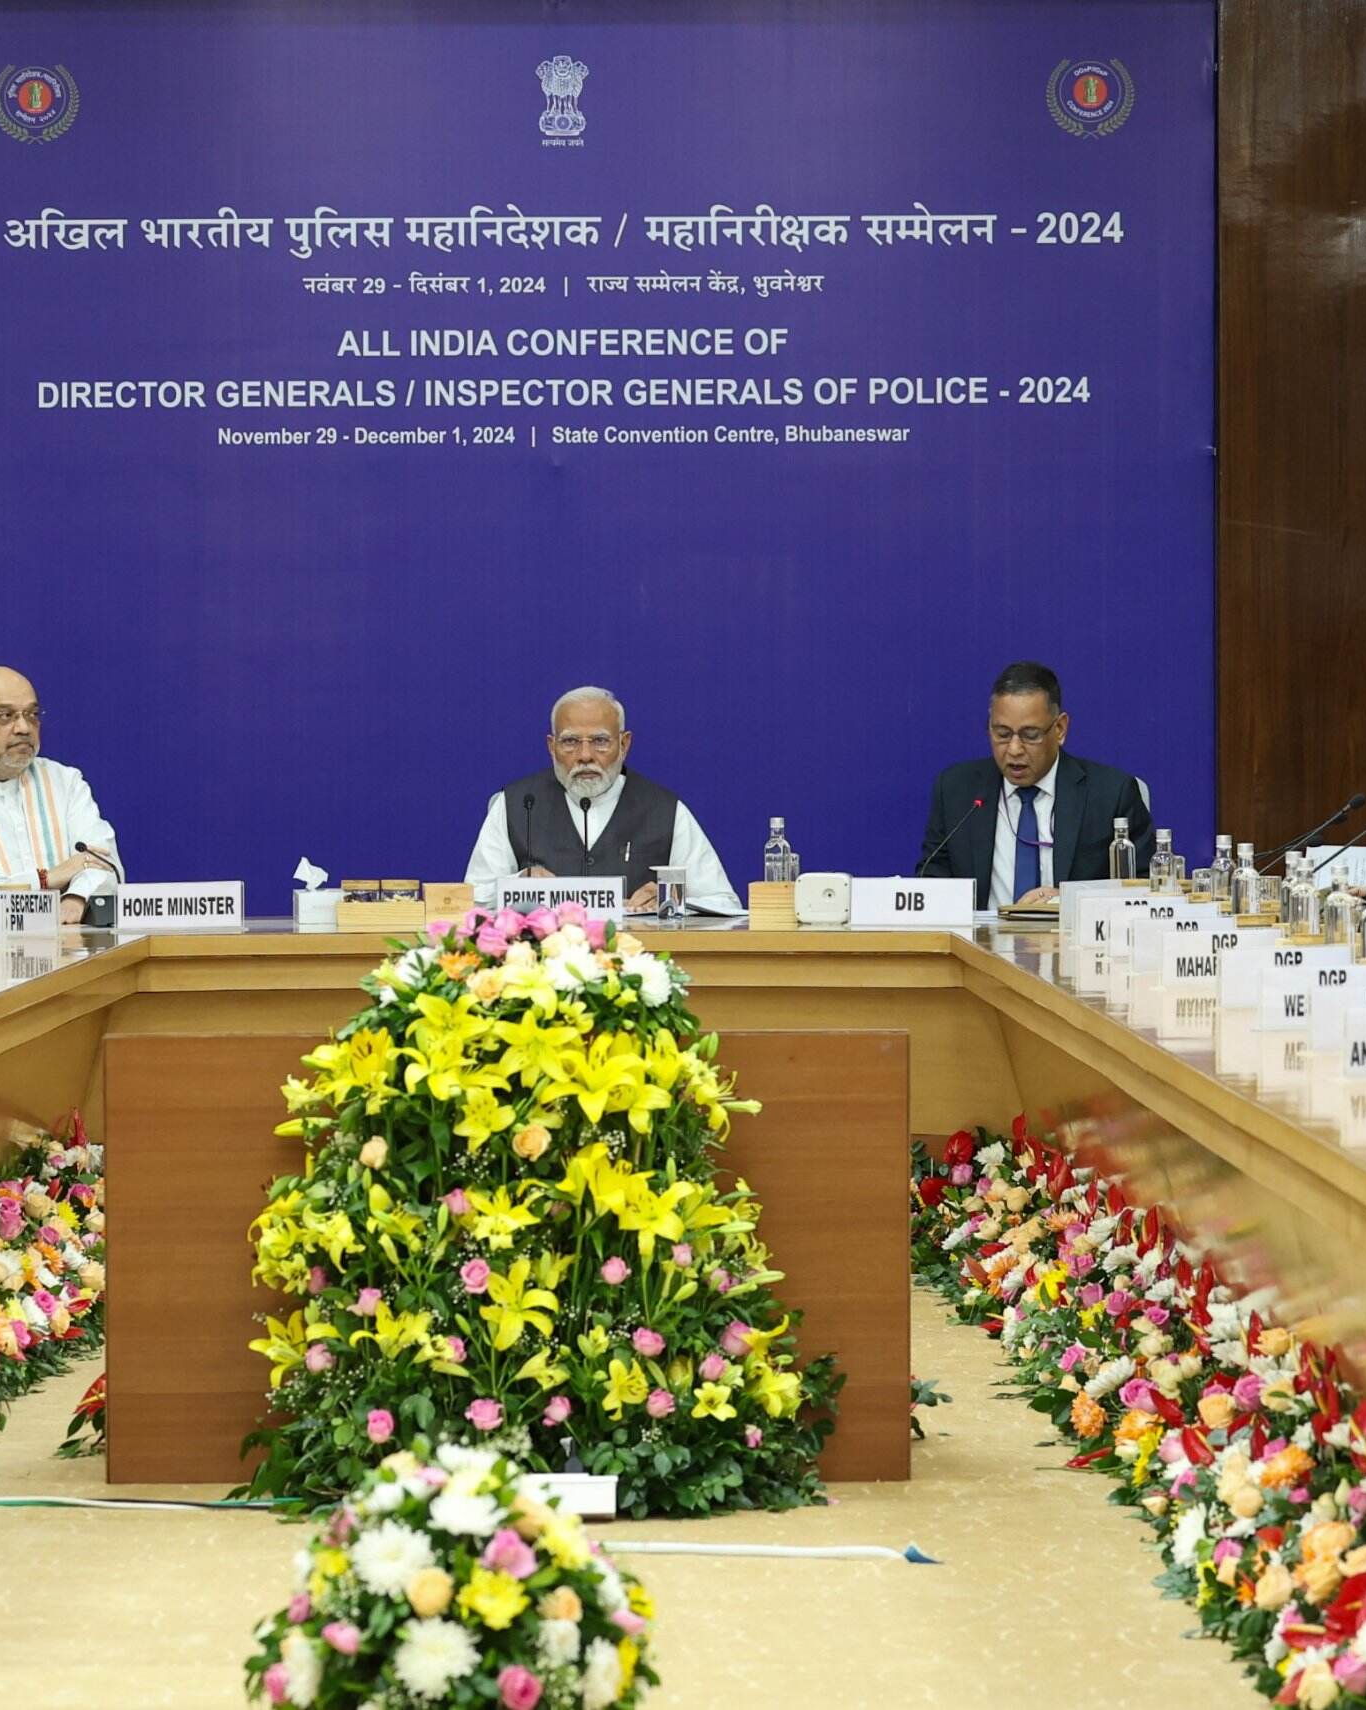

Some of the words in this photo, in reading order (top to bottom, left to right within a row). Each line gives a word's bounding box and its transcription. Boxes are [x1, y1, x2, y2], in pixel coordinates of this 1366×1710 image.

[4, 207, 128, 250] अखिल
[141, 207, 273, 249] भारतीय
[284, 206, 394, 259] पुलिस
[404, 204, 602, 253] महानिदेशक
[614, 213, 627, 248] /
[644, 204, 850, 253] महानिरीक्षक
[861, 202, 997, 246] सम्मेलन
[1037, 211, 1124, 244] 2024
[302, 273, 357, 294] नवंबर
[363, 277, 386, 294] 29
[408, 271, 470, 294] दिसंबर
[477, 277, 493, 297] 1,
[500, 277, 546, 294] 2024
[587, 277, 629, 293] राज्य
[634, 270, 702, 293] सम्मेलन
[707, 269, 745, 296] केंद्र,
[753, 269, 825, 298] भुवनेश्वर
[337, 329, 401, 357] ALL
[411, 329, 498, 357] INDIA
[507, 328, 734, 357] CONFERENCE
[744, 327, 788, 356] OF
[39, 380, 207, 408] DIRECTOR
[216, 379, 395, 408] GENERALS
[405, 379, 416, 407] /
[425, 378, 614, 407] INSPECTOR
[623, 377, 803, 406] GENERALS
[814, 377, 858, 405] OF
[868, 376, 989, 405] POLICE
[1018, 376, 1091, 404] 2024
[219, 427, 312, 445] November
[316, 427, 338, 445] 29
[355, 427, 446, 445] December
[452, 427, 468, 447] 1,
[472, 426, 516, 444] 2024
[552, 425, 598, 444] State
[604, 425, 709, 444] Convention
[713, 425, 780, 447] Centre,
[785, 424, 911, 443] Bhubaneswar
[11, 895, 53, 913] SECRETARY
[123, 898, 163, 916] HOME
[168, 896, 234, 915] MINISTER
[503, 891, 545, 907] PRIME
[550, 890, 616, 908] MINISTER
[894, 891, 925, 911] DIB
[11, 915, 25, 931] PM
[1212, 933, 1238, 954] DGP
